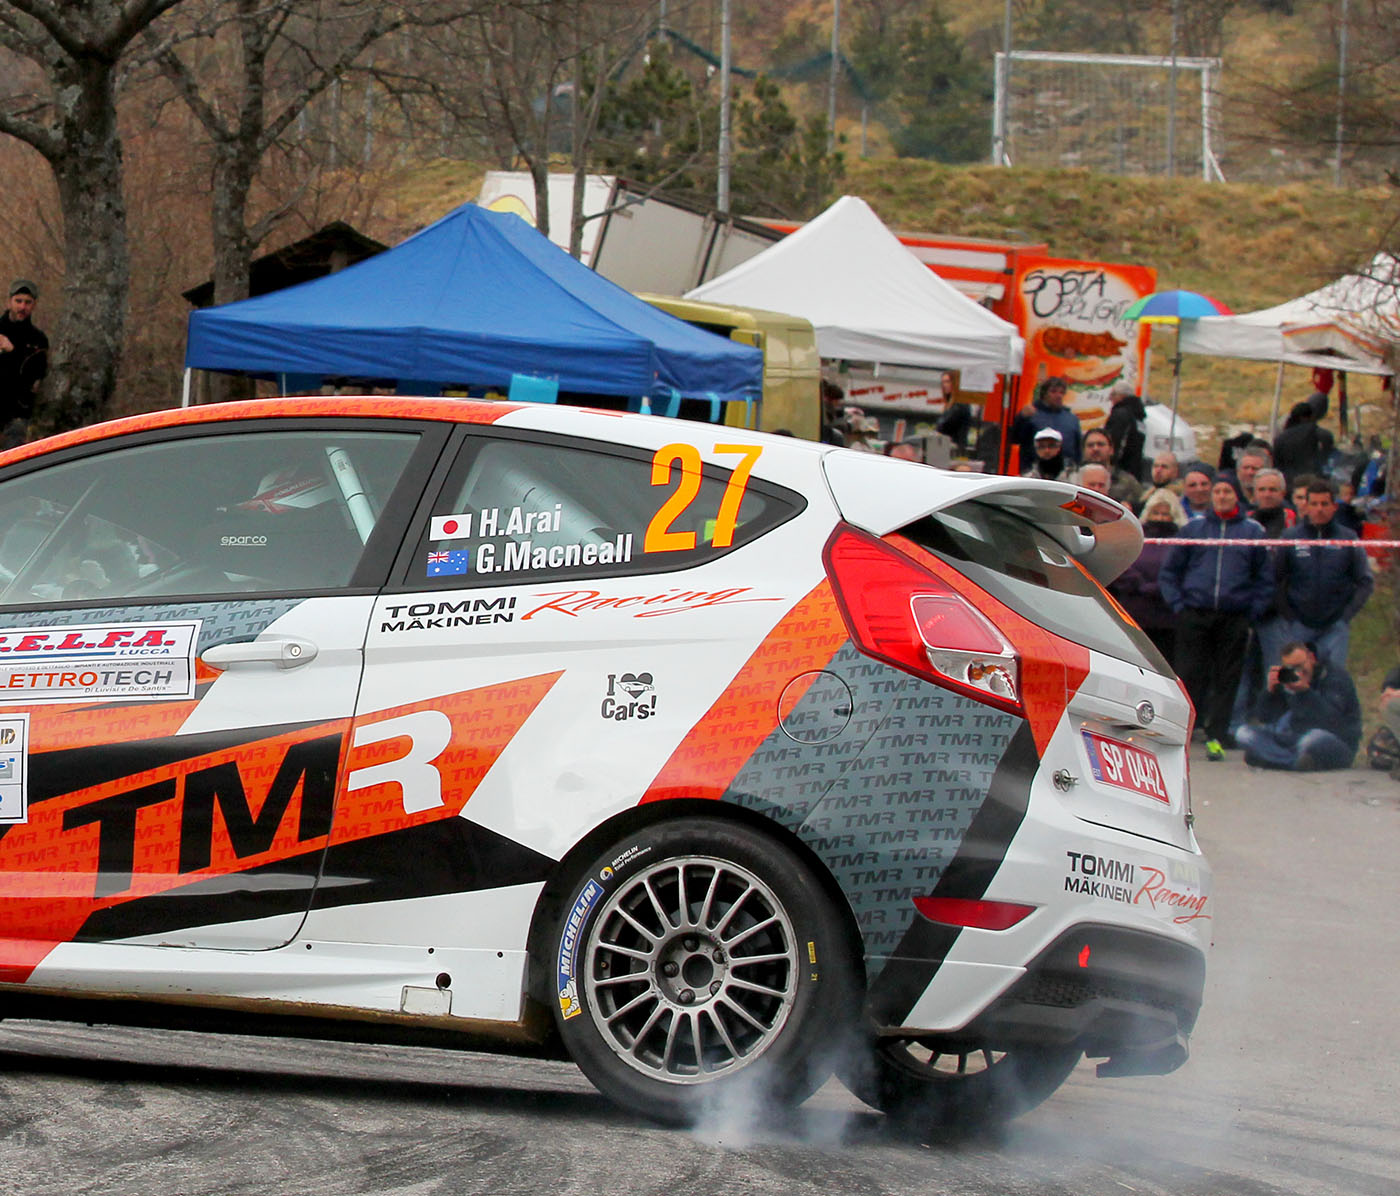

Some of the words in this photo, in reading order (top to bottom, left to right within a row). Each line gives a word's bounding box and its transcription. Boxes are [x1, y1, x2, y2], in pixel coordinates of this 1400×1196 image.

[643, 442, 764, 553] 27
[478, 503, 562, 538] H.Arai
[220, 535, 267, 546] sparco
[475, 533, 633, 574] G.Macneall
[385, 596, 517, 619] TOMMI
[521, 587, 785, 620] Racing
[82, 607, 125, 621] TMR
[155, 606, 201, 621] TMR
[228, 606, 276, 621] TMR
[381, 612, 515, 633] MÄKINEN
[781, 618, 833, 635] TMR
[803, 632, 850, 649] TMR
[120, 648, 170, 656] LUCCA
[764, 655, 816, 675] TMR
[484, 685, 532, 701] TMR
[727, 680, 777, 699] TMR
[870, 680, 923, 694] TMR
[601, 695, 657, 721] Cars!
[893, 696, 944, 710] TMR
[32, 713, 76, 731] TMR
[105, 714, 150, 733] TMR
[709, 719, 760, 736] TMR
[853, 716, 906, 733] TMR
[916, 714, 965, 727] TMR
[974, 714, 1013, 727] TMR
[54, 726, 97, 745] TMR
[469, 724, 516, 741] TMR
[938, 733, 982, 746] TMR
[731, 734, 779, 750] TMR
[812, 740, 866, 756] TMR
[877, 734, 929, 749] TMR
[355, 742, 401, 760] TMR
[751, 747, 802, 764] TMR
[901, 751, 951, 766] TMR
[959, 751, 999, 766] TMR
[693, 756, 743, 776] TMR
[774, 762, 826, 779] TMR
[838, 755, 889, 772] TMR
[1100, 741, 1124, 782] SP
[1125, 749, 1166, 798] 0442
[861, 772, 912, 787] TMR
[923, 770, 971, 783] TMR
[796, 778, 850, 794] TMR
[61, 709, 452, 901] TMR
[824, 795, 873, 810] TMR
[883, 790, 935, 805] TMR
[843, 811, 895, 827] TMR
[907, 808, 958, 823] TMR
[867, 830, 919, 844] TMR
[16, 846, 59, 865] TMR
[828, 851, 880, 868] TMR
[892, 848, 944, 862] TMR
[1066, 850, 1135, 884] TOMMI
[852, 868, 903, 885] TMR
[1064, 875, 1133, 904] MÄKINEN
[1132, 865, 1213, 924] Racing
[560, 884, 597, 977] MICHELIN
